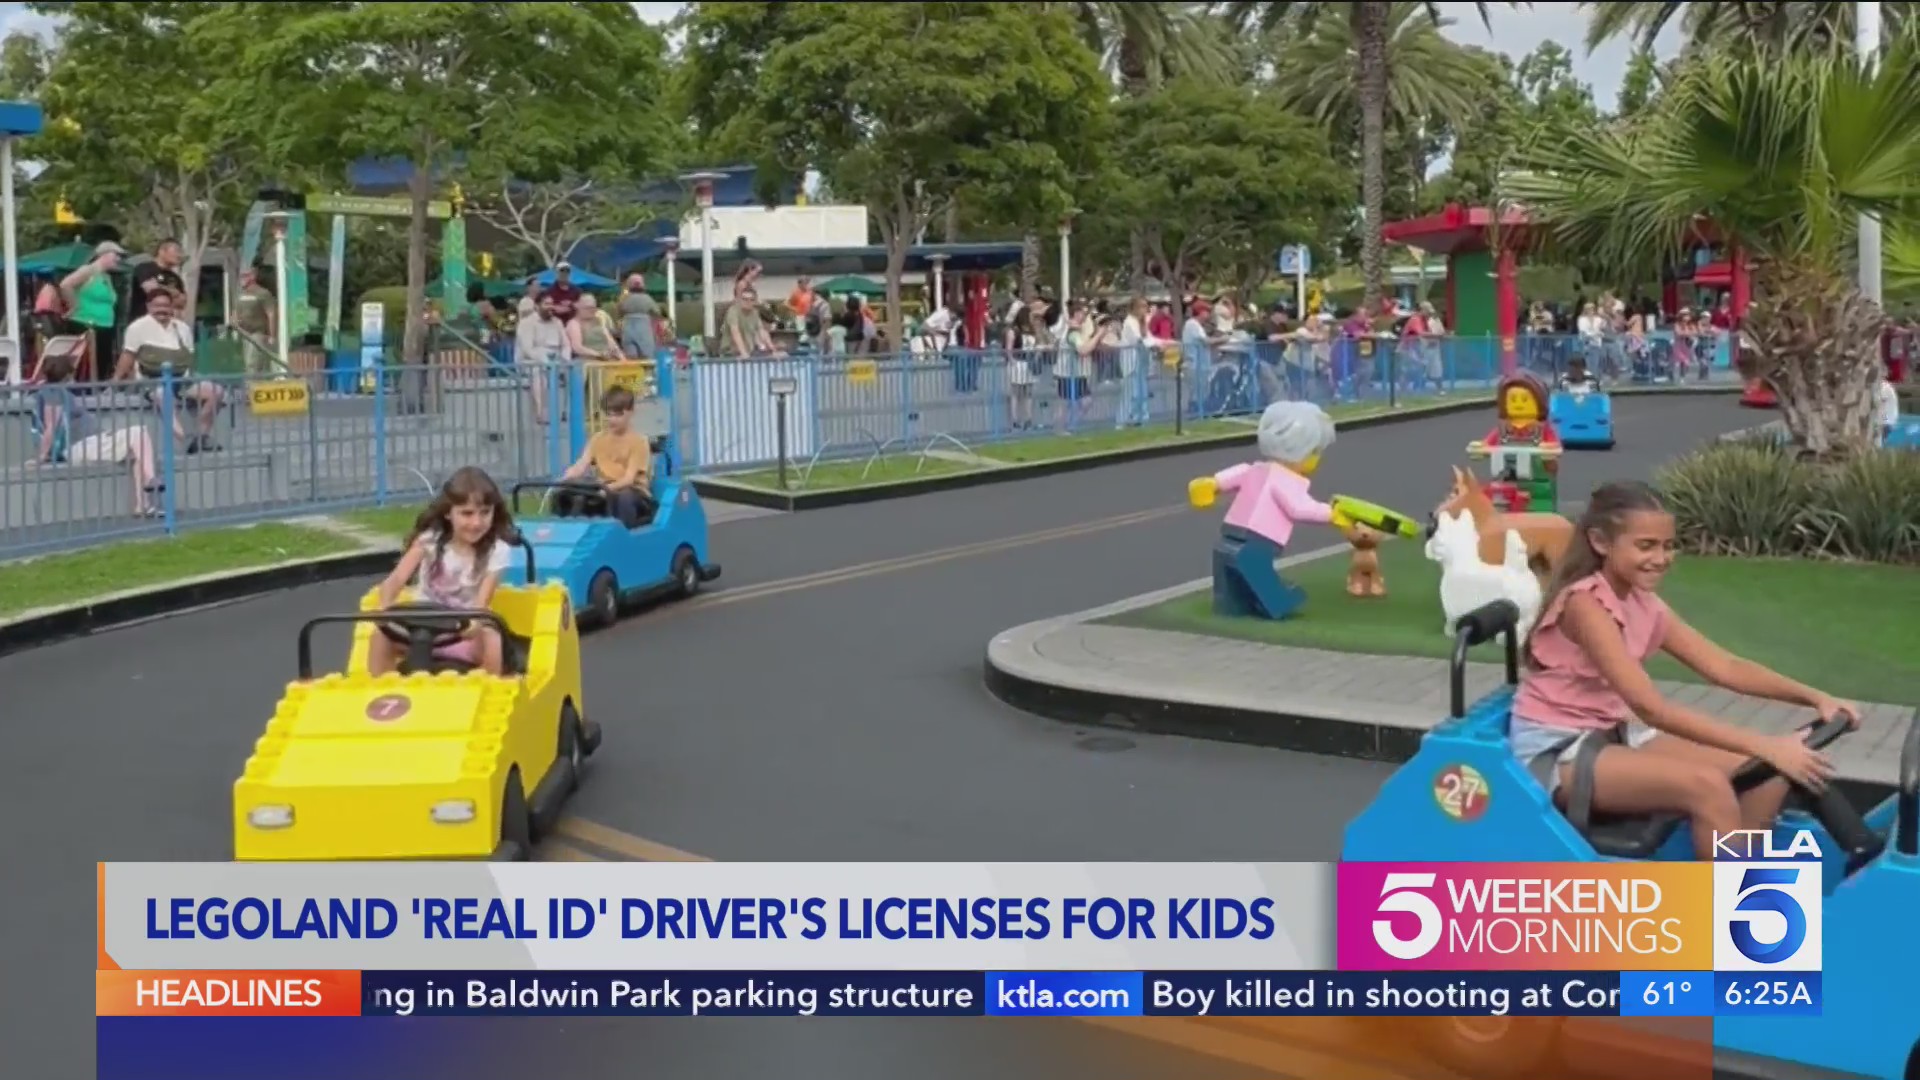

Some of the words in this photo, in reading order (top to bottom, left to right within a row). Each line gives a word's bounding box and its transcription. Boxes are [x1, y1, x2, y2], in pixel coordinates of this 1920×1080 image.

[254, 388, 287, 403] EXIT
[379, 698, 399, 716] 7
[1442, 772, 1480, 810] 27
